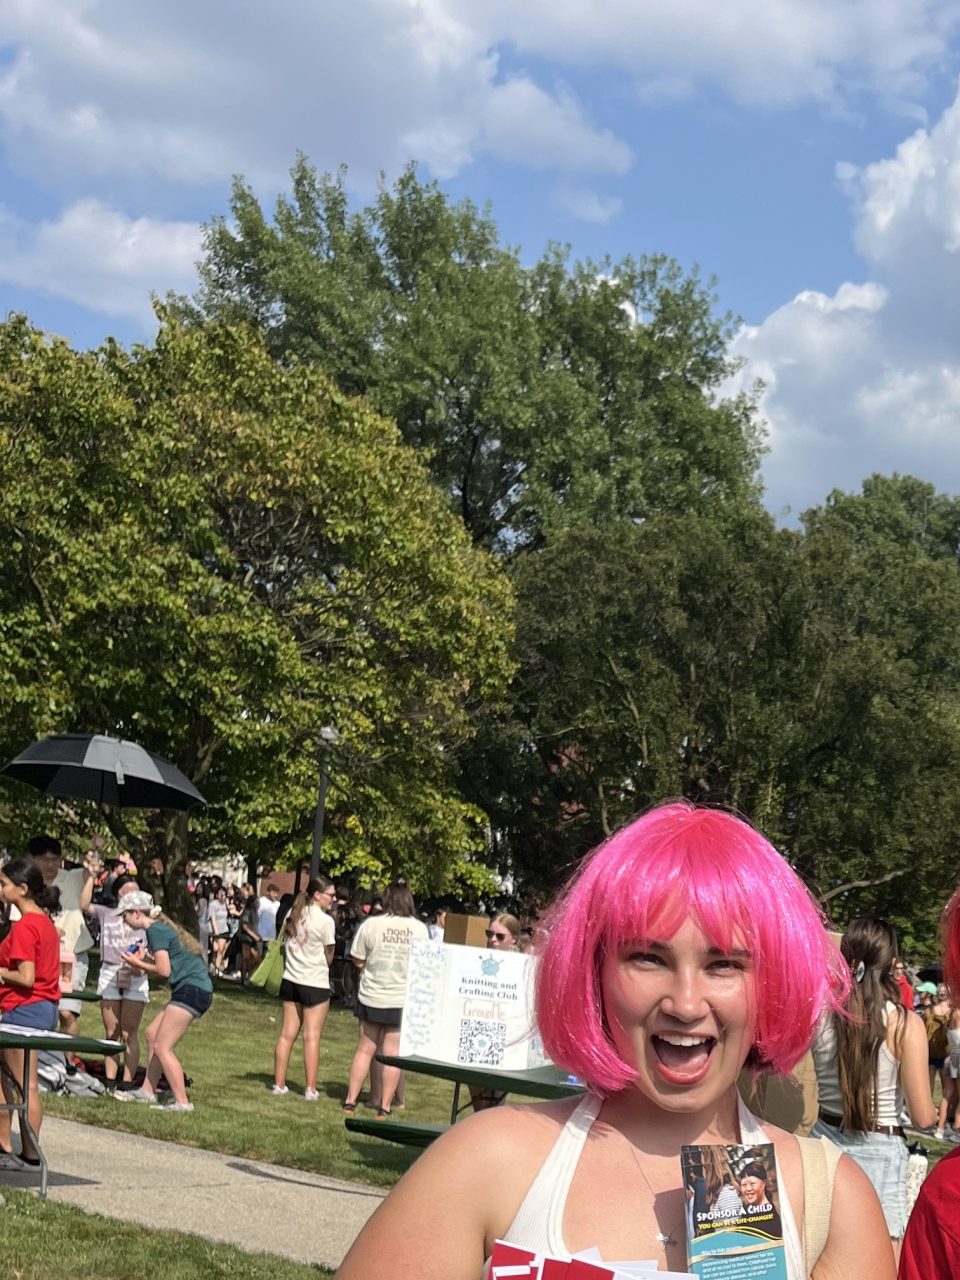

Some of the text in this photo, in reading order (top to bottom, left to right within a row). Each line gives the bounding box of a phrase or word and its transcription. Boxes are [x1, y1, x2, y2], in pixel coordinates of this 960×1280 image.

[387, 927, 413, 936] noah
[383, 932, 411, 944] kaha
[462, 977, 498, 989] Knitting
[459, 987, 518, 1000] Crafting Club
[697, 1209, 737, 1221] SPONSOR
[747, 1203, 773, 1214] CHILD
